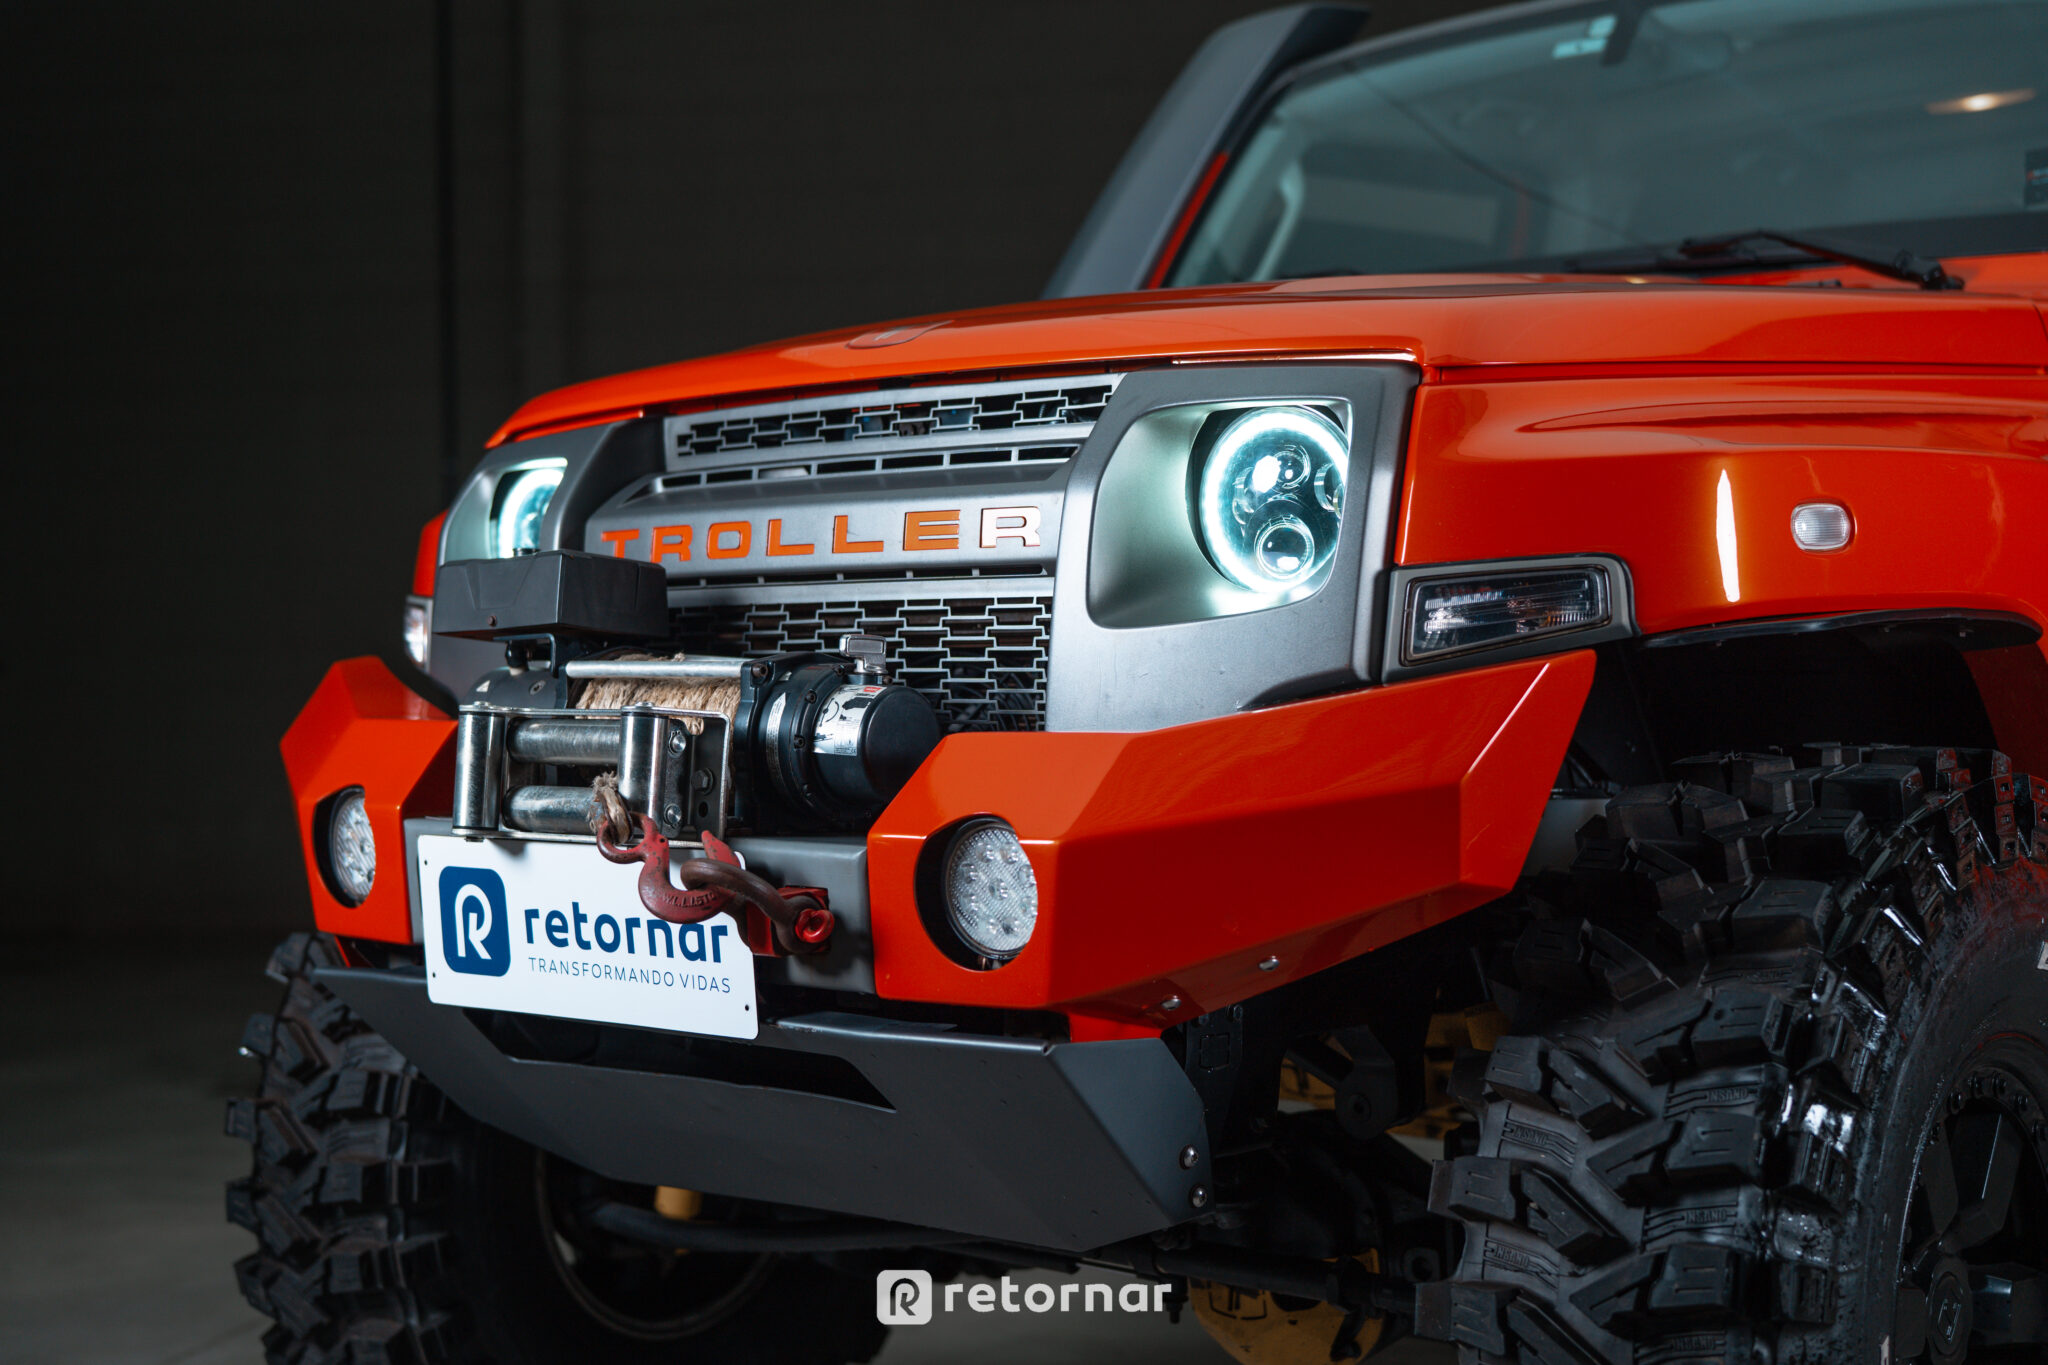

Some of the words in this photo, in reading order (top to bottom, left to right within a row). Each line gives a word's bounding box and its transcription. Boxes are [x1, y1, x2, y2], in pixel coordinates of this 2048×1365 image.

[601, 505, 1040, 562] TROLLER
[524, 902, 728, 963] retornar
[529, 957, 674, 987] TRANSFORMANDO
[680, 973, 731, 994] VIDAS
